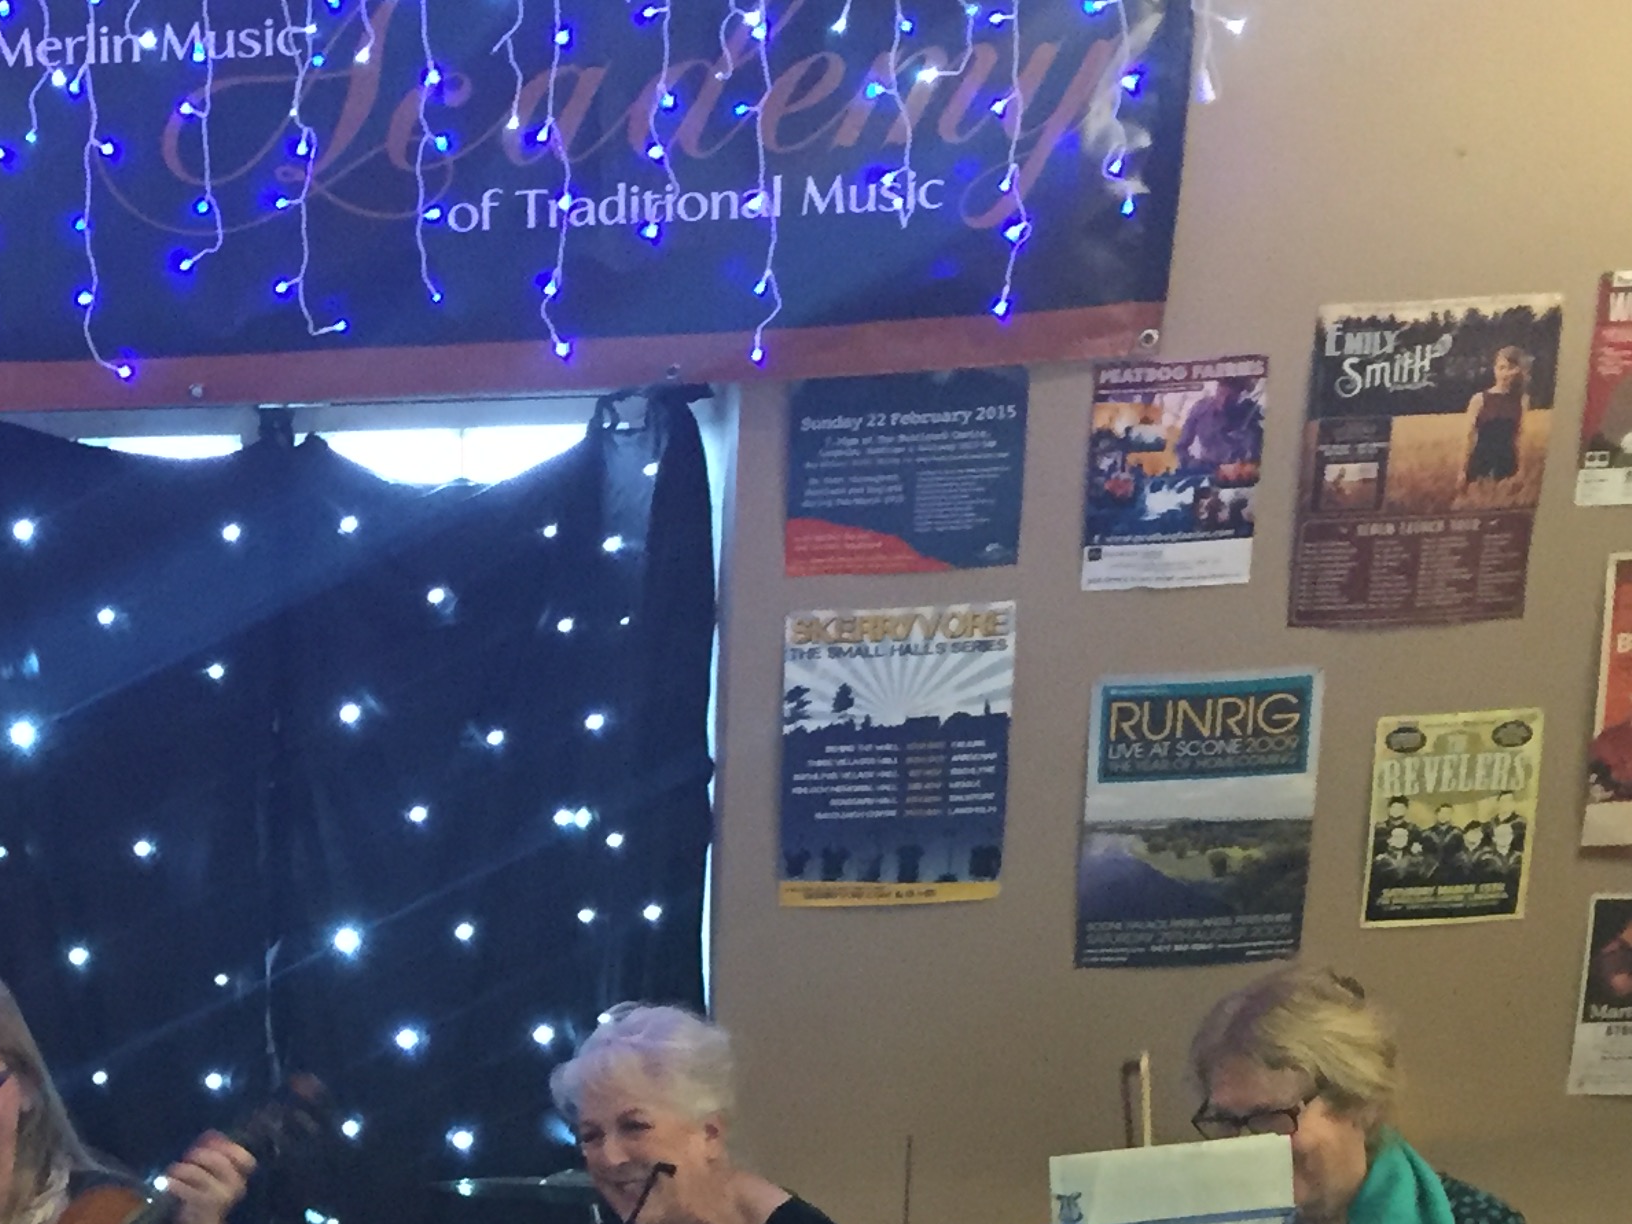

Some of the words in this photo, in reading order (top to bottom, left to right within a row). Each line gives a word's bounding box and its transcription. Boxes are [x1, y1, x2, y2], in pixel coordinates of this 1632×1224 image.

[166, 23, 305, 66] Music
[447, 189, 500, 232] of
[516, 176, 783, 229] Traditional
[802, 169, 946, 216] Music
[800, 415, 864, 431] Sunday
[866, 413, 887, 428] 22
[890, 410, 972, 426] February
[975, 404, 1018, 421] 2015
[790, 610, 1009, 645] SKERRYVORE
[789, 647, 821, 660] THE
[827, 645, 884, 658] SMALL
[890, 641, 946, 656] HALLS
[1109, 692, 1301, 742] RUNRIG
[1108, 742, 1144, 760] LIVE
[1150, 741, 1171, 756] AT
[1175, 738, 1243, 757] SCONE
[1382, 752, 1530, 798] REVELERS
